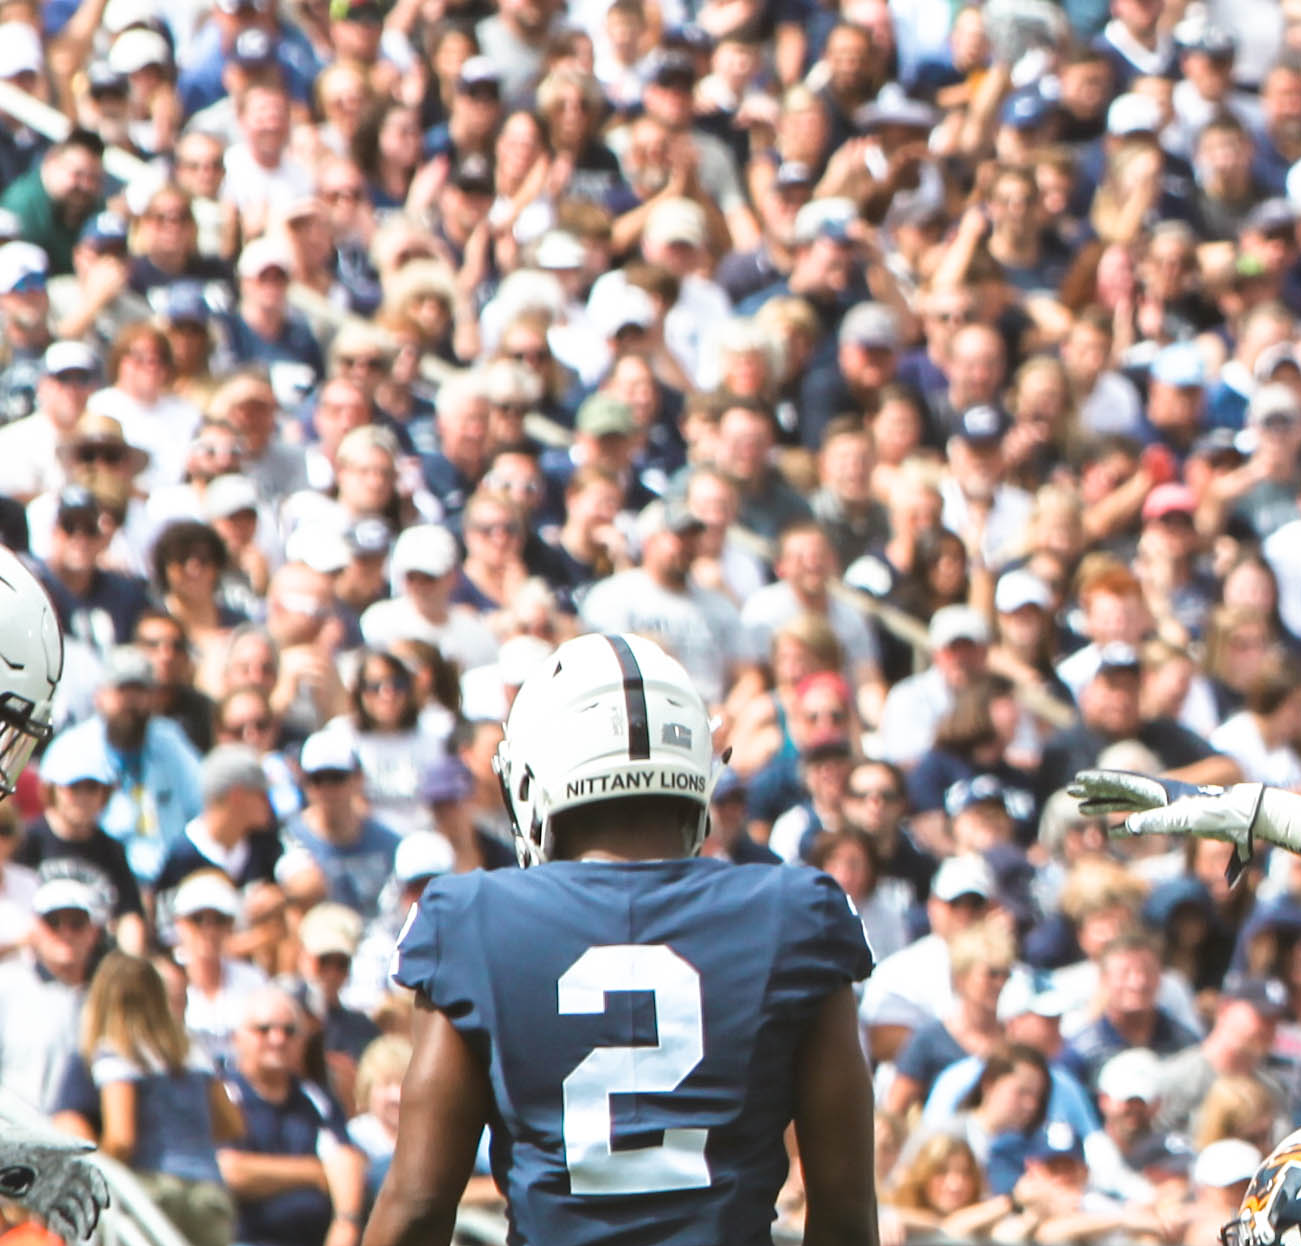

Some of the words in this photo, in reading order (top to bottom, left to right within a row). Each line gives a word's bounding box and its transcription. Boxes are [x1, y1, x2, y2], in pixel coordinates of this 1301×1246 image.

[566, 771, 655, 799] NITTANY
[660, 771, 706, 793] LIONS
[557, 944, 712, 1195] 2
